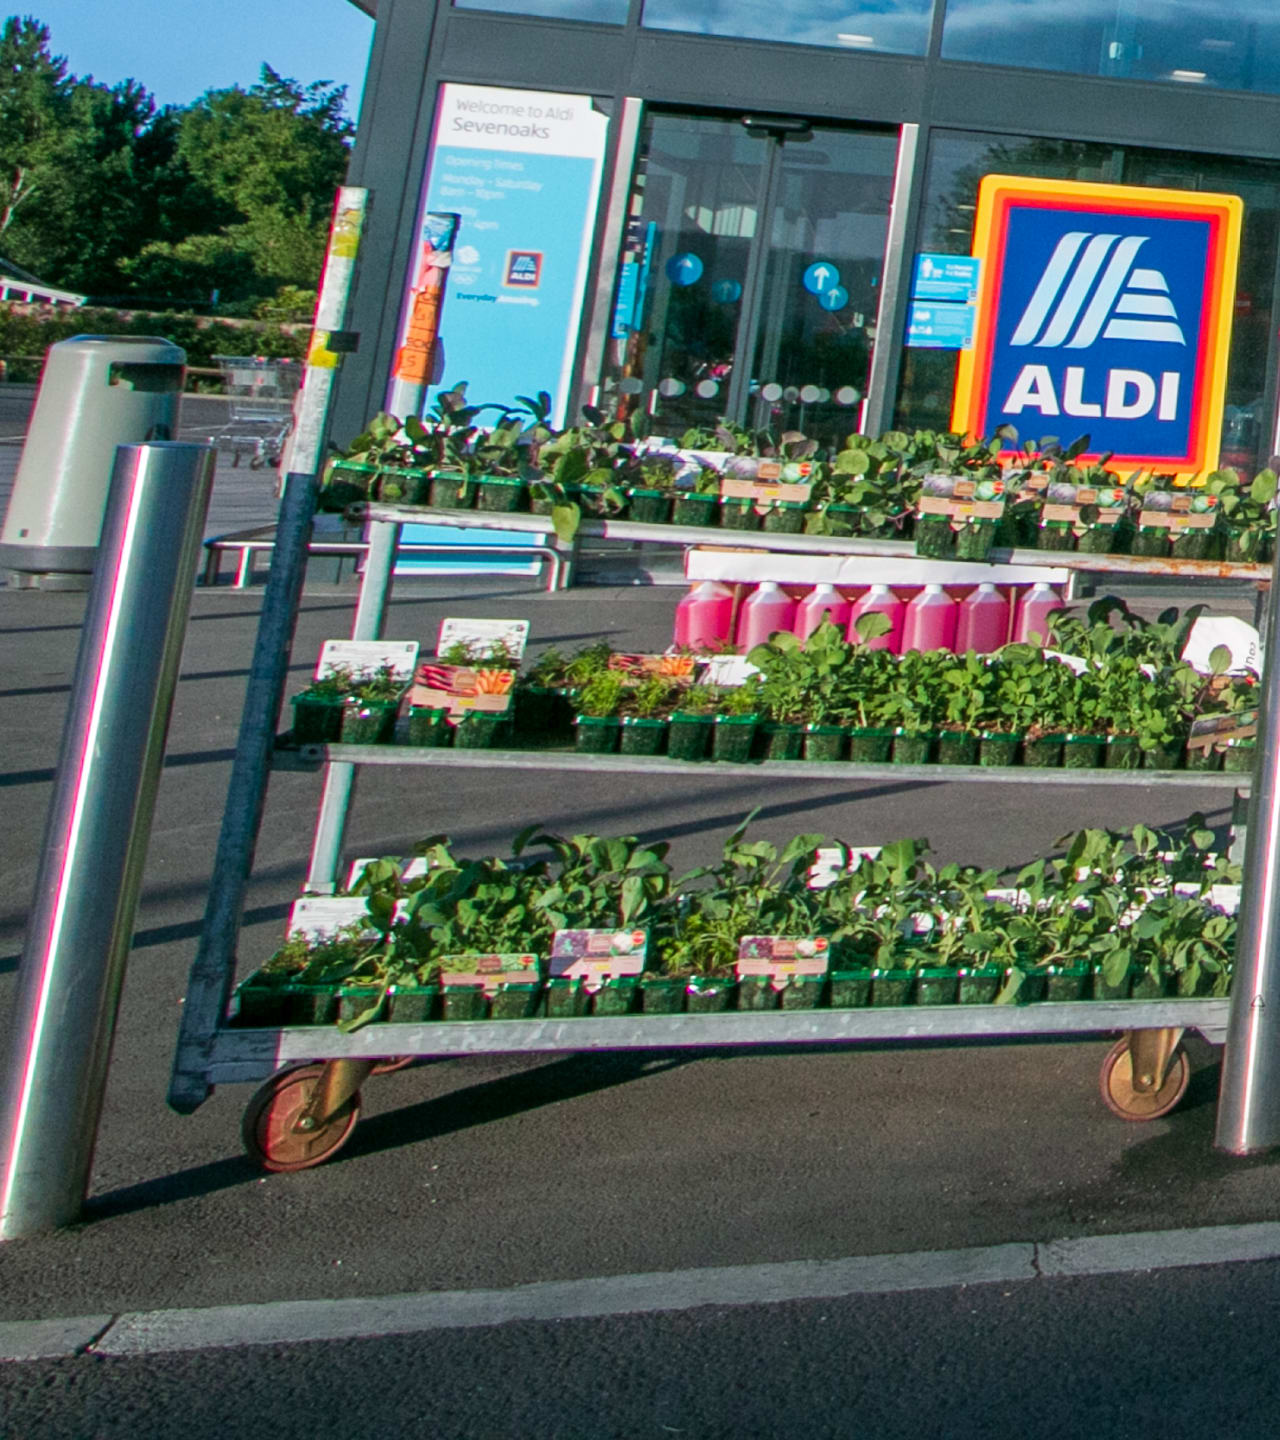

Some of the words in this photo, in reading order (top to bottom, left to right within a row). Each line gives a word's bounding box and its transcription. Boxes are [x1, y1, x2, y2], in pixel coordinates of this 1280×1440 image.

[456, 99, 524, 117] Welcome
[527, 105, 542, 118] to
[545, 107, 574, 121] Aldi
[452, 116, 551, 139] Sevenoaks
[510, 271, 537, 281] ALDI
[1002, 364, 1180, 421] ALDI
